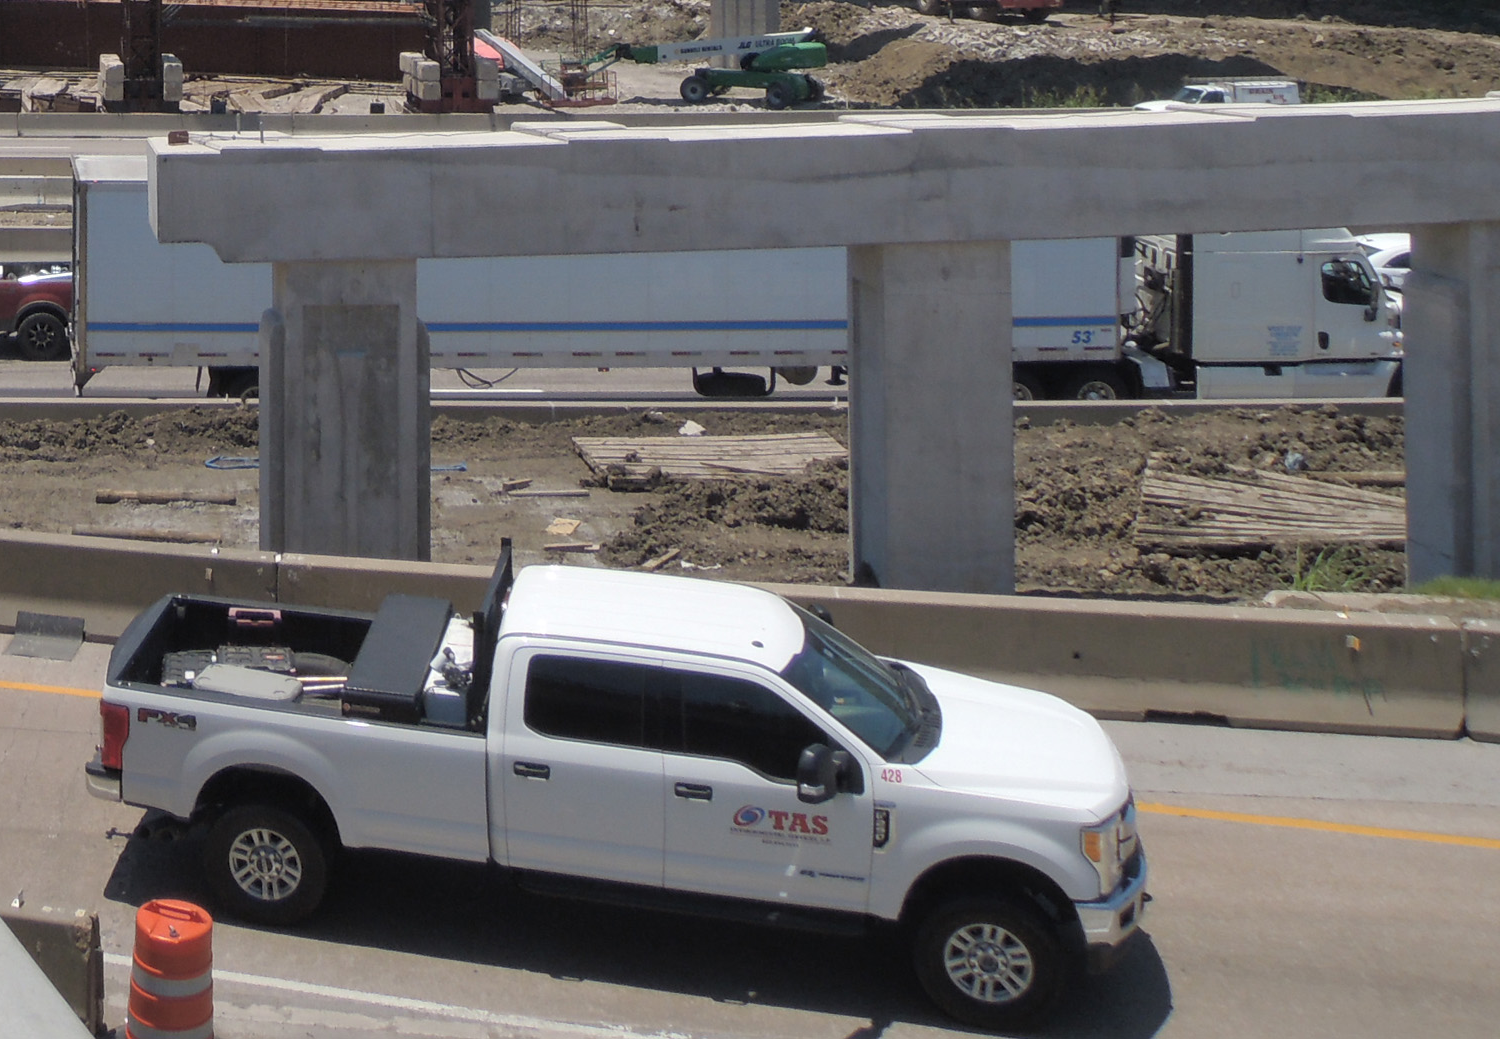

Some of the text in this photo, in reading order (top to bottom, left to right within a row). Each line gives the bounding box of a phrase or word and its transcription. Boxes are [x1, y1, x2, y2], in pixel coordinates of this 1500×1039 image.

[738, 40, 752, 49] JLG
[755, 39, 775, 48] ULTRA
[137, 707, 197, 729] FX4
[881, 768, 903, 784] 428
[768, 810, 829, 835] TAS
